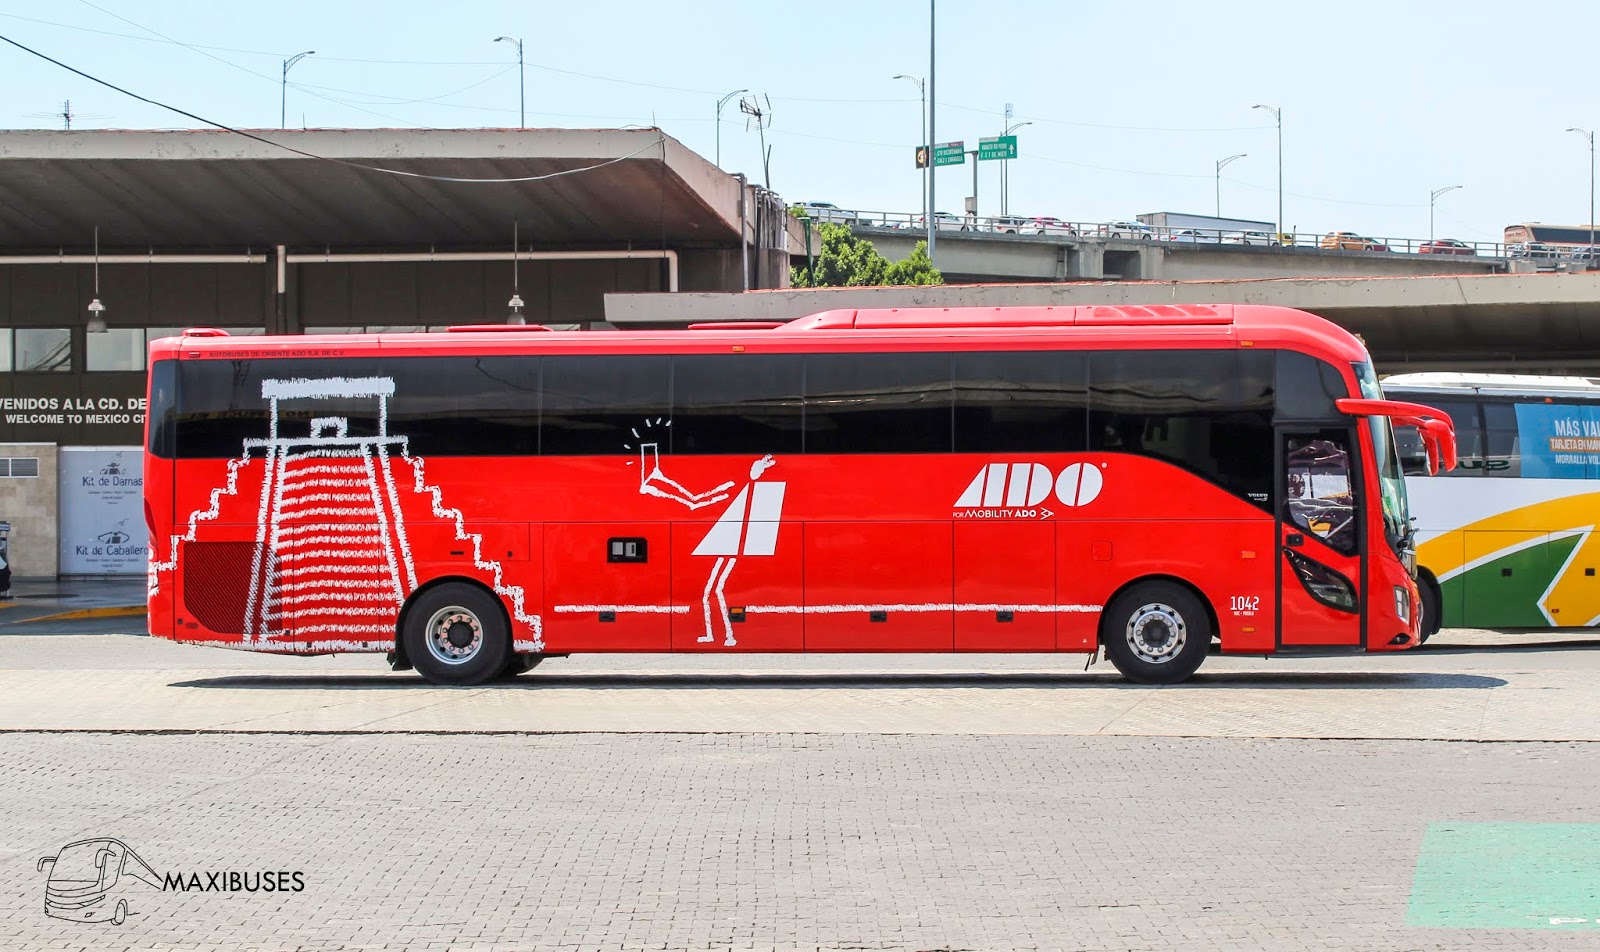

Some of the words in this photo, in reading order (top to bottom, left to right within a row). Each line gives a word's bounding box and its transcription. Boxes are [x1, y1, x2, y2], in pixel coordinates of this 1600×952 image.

[63, 398, 73, 410] A
[76, 398, 95, 410] LA
[98, 398, 123, 410] CD.
[127, 398, 147, 410] DE
[6, 414, 64, 424] WELCOME
[67, 414, 82, 424] TO
[86, 414, 130, 424] MEXICO
[1554, 416, 1580, 436] MÁS
[1550, 438, 1577, 450] TARJETA
[83, 476, 95, 486] Kit
[98, 476, 109, 486] de
[113, 476, 143, 486] Damas
[952, 462, 1104, 508] ADO
[964, 509, 1013, 518] MOBILITY
[1014, 509, 1037, 518] ADO
[76, 545, 88, 555] Kit
[92, 545, 102, 555] de
[1230, 596, 1259, 611] 1042
